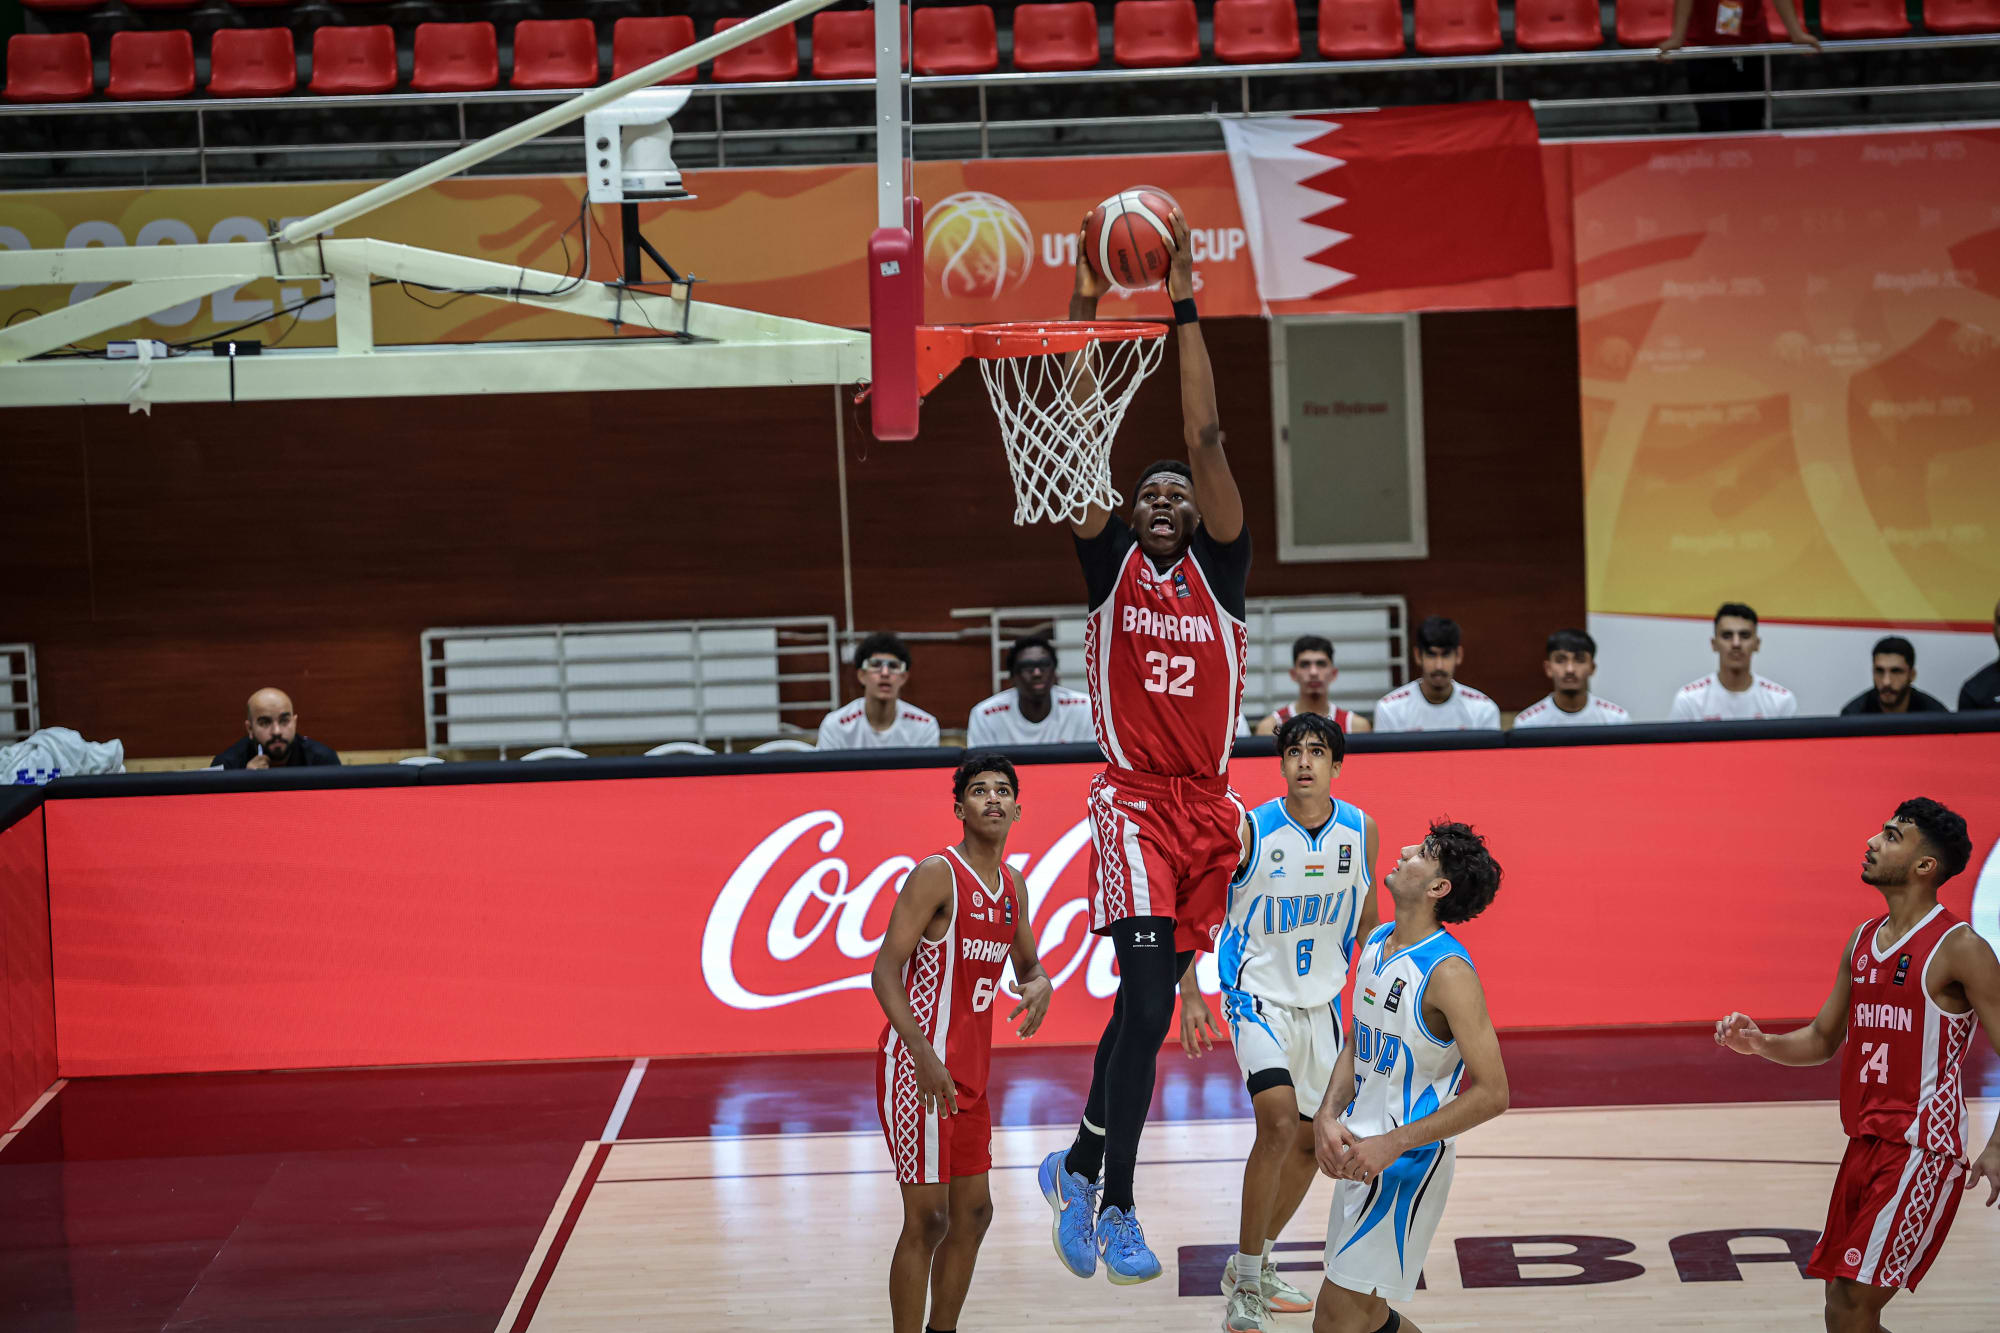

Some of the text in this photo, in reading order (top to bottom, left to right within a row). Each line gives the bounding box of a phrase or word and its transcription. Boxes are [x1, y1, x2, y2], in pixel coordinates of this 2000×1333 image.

[1190, 227, 1247, 264] CUP
[1122, 605, 1215, 643] BAHRAIN
[1144, 650, 1196, 697] 32
[1296, 938, 1315, 977] 6
[972, 977, 1001, 1013] 6
[1177, 1228, 1823, 1297] FBA
